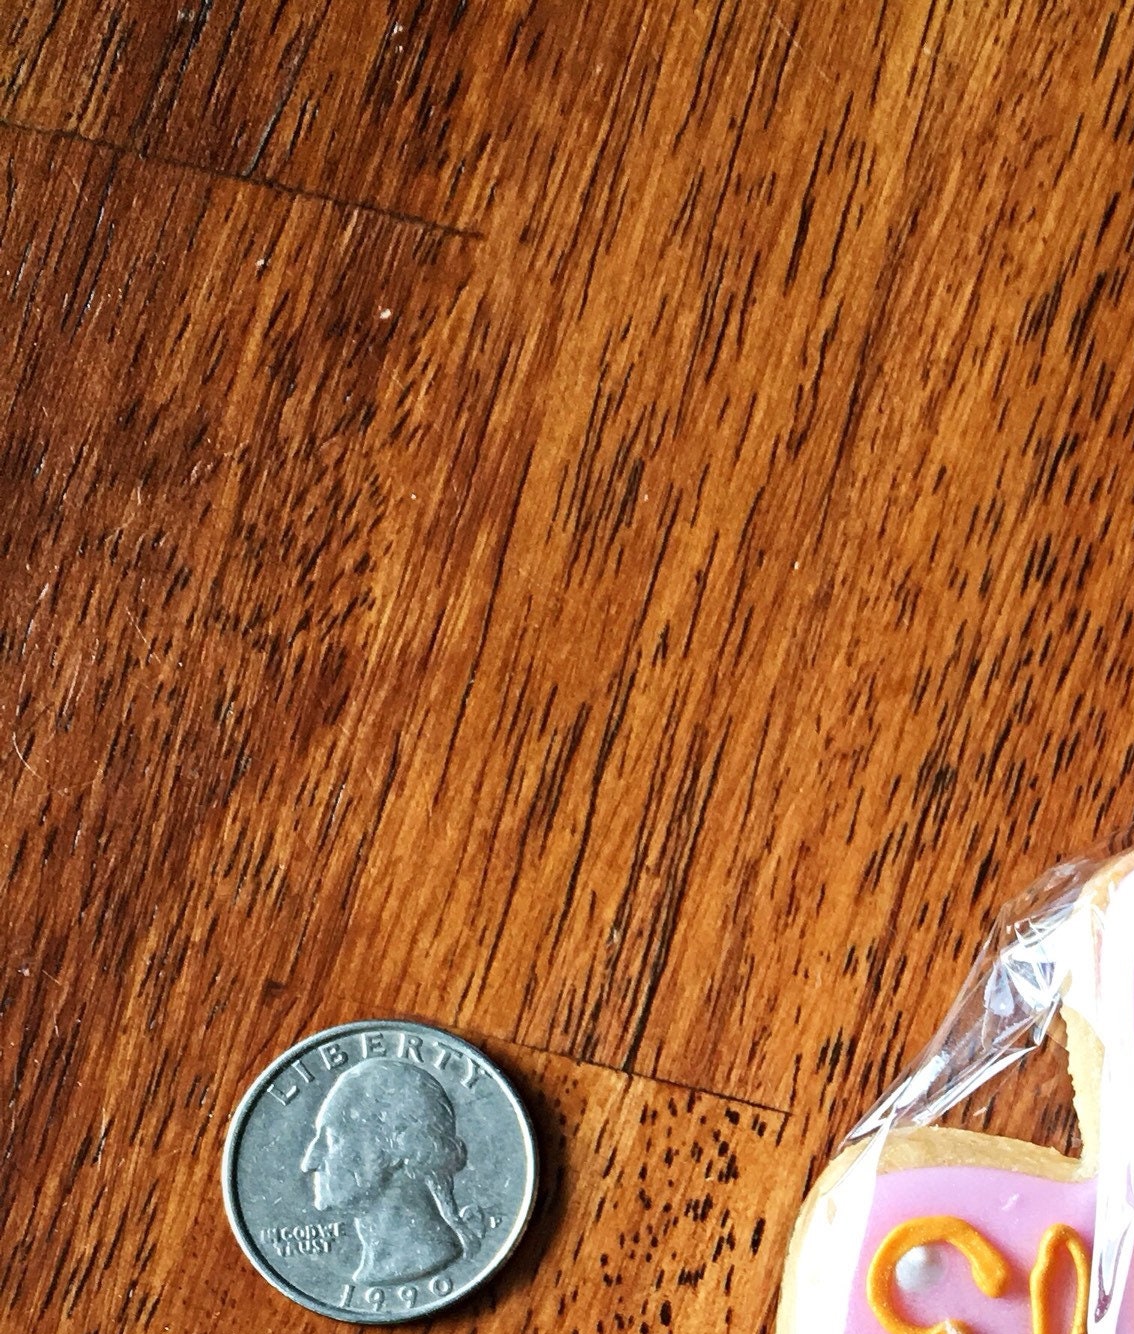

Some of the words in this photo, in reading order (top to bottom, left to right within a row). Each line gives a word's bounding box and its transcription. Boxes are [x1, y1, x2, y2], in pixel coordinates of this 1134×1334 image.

[266, 1032, 492, 1107] LIBERTY
[280, 1224, 320, 1242] GOD
[338, 1274, 454, 1312] 1990
